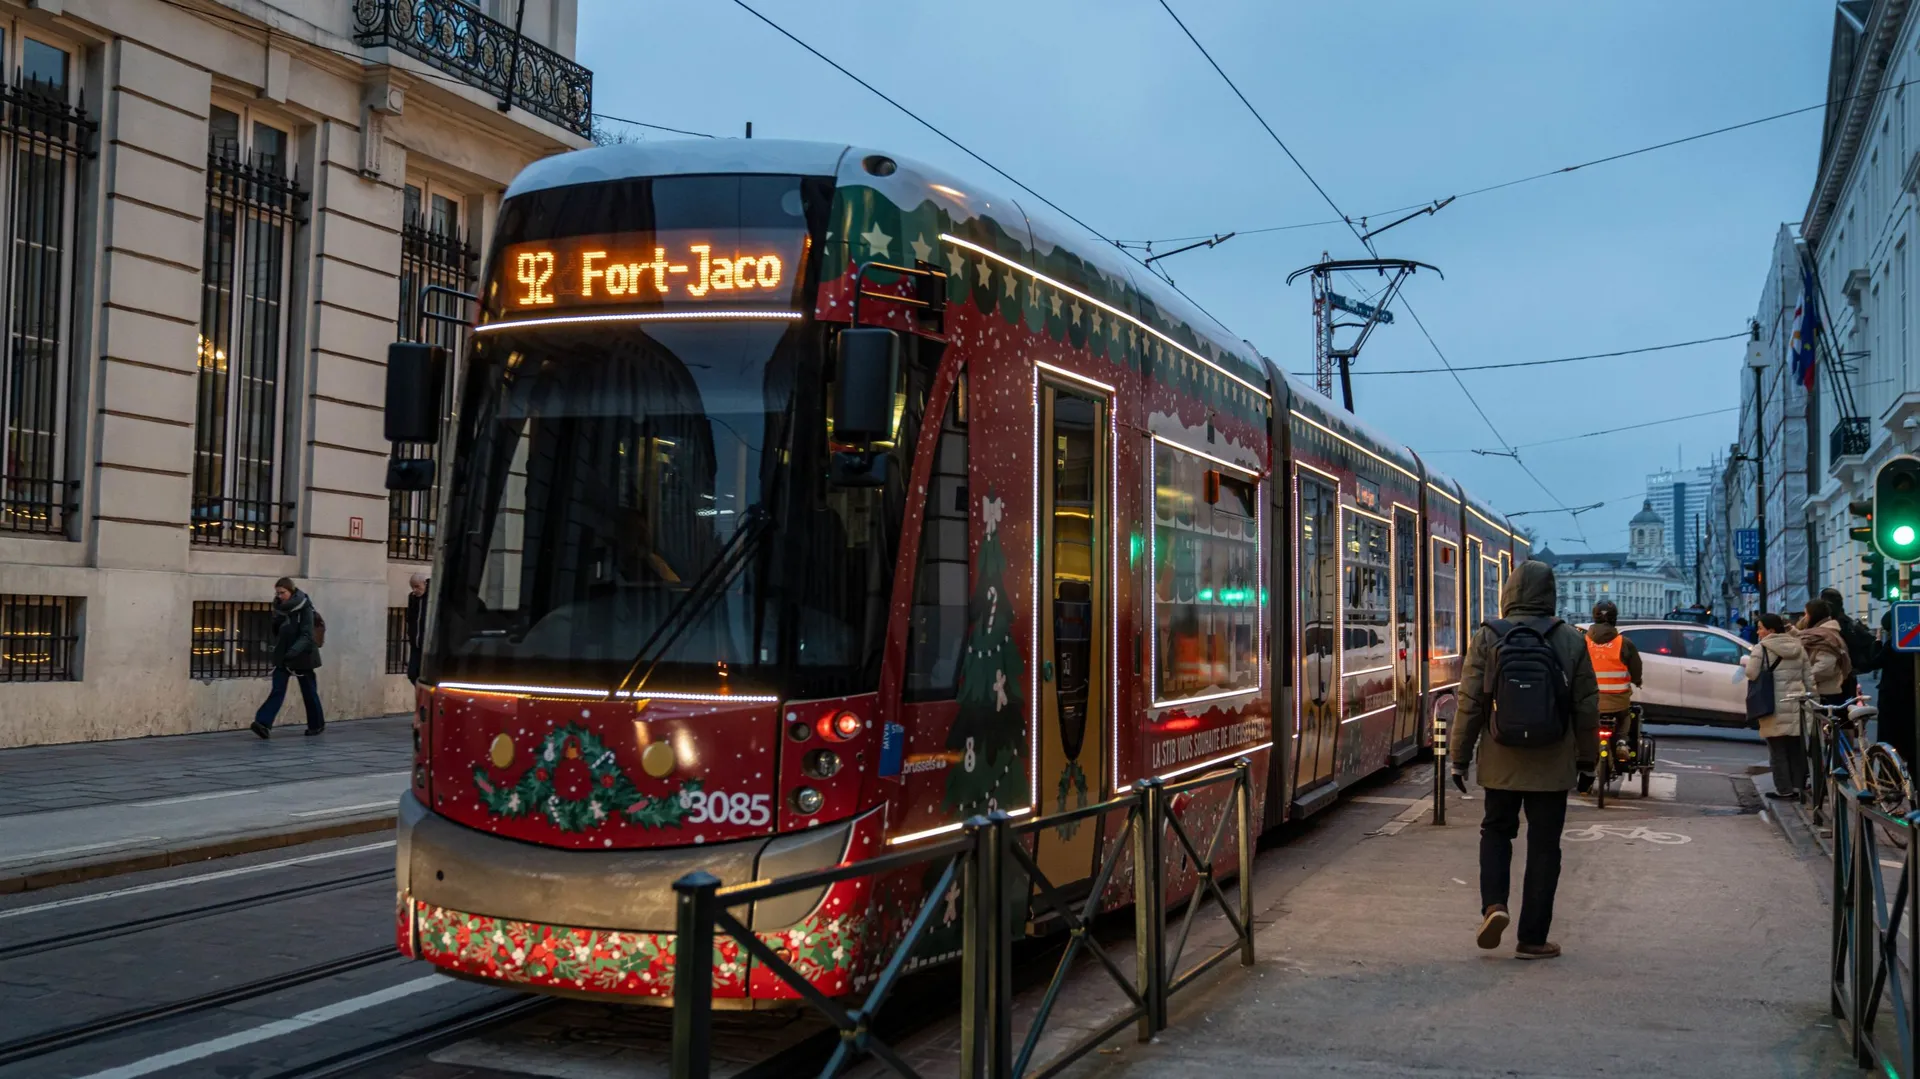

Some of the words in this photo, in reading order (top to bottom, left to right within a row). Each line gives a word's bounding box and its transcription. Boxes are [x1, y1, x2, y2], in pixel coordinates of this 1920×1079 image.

[517, 251, 554, 305] 92
[582, 245, 782, 297] Fort-Jaco
[353, 521, 360, 535] H
[882, 724, 890, 750] MIVB
[1152, 742, 1161, 769] LA
[1162, 739, 1176, 766] STIB
[1177, 735, 1193, 762] VOUS
[1221, 726, 1228, 749] DE
[688, 791, 770, 826] 3085
